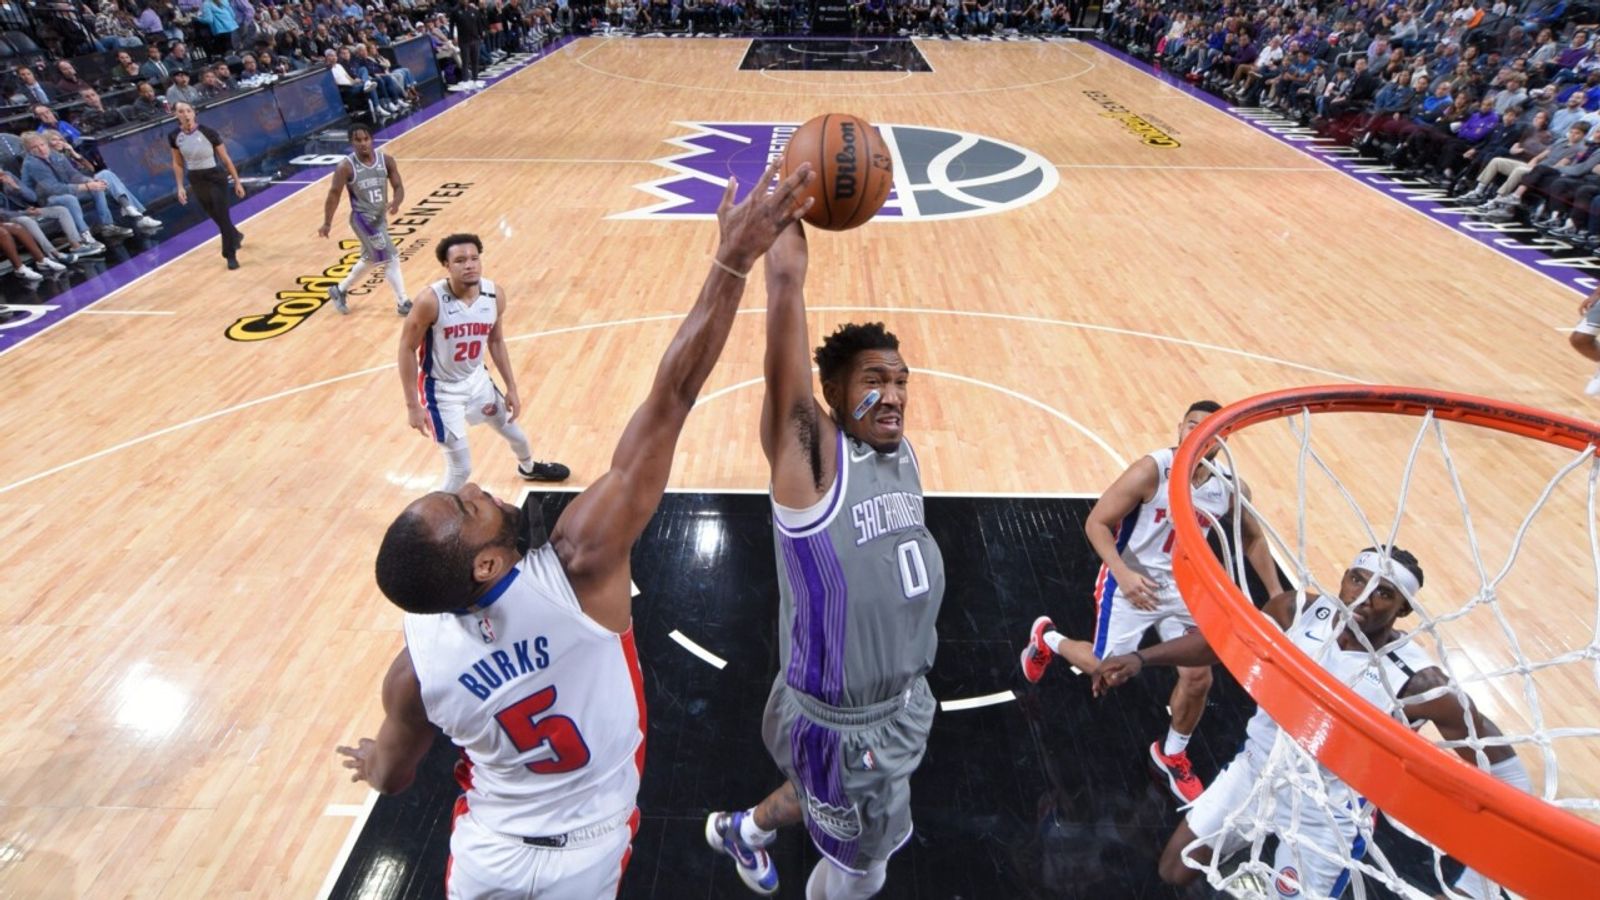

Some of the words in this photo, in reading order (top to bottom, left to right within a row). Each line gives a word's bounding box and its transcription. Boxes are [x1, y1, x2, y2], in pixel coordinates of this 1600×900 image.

[835, 121, 857, 200] Wilson
[368, 188, 383, 203] 15
[386, 181, 474, 237] CENTER
[453, 340, 482, 362] 20
[897, 539, 929, 598] 0
[457, 635, 550, 702] BURKS
[493, 684, 591, 774] 5
